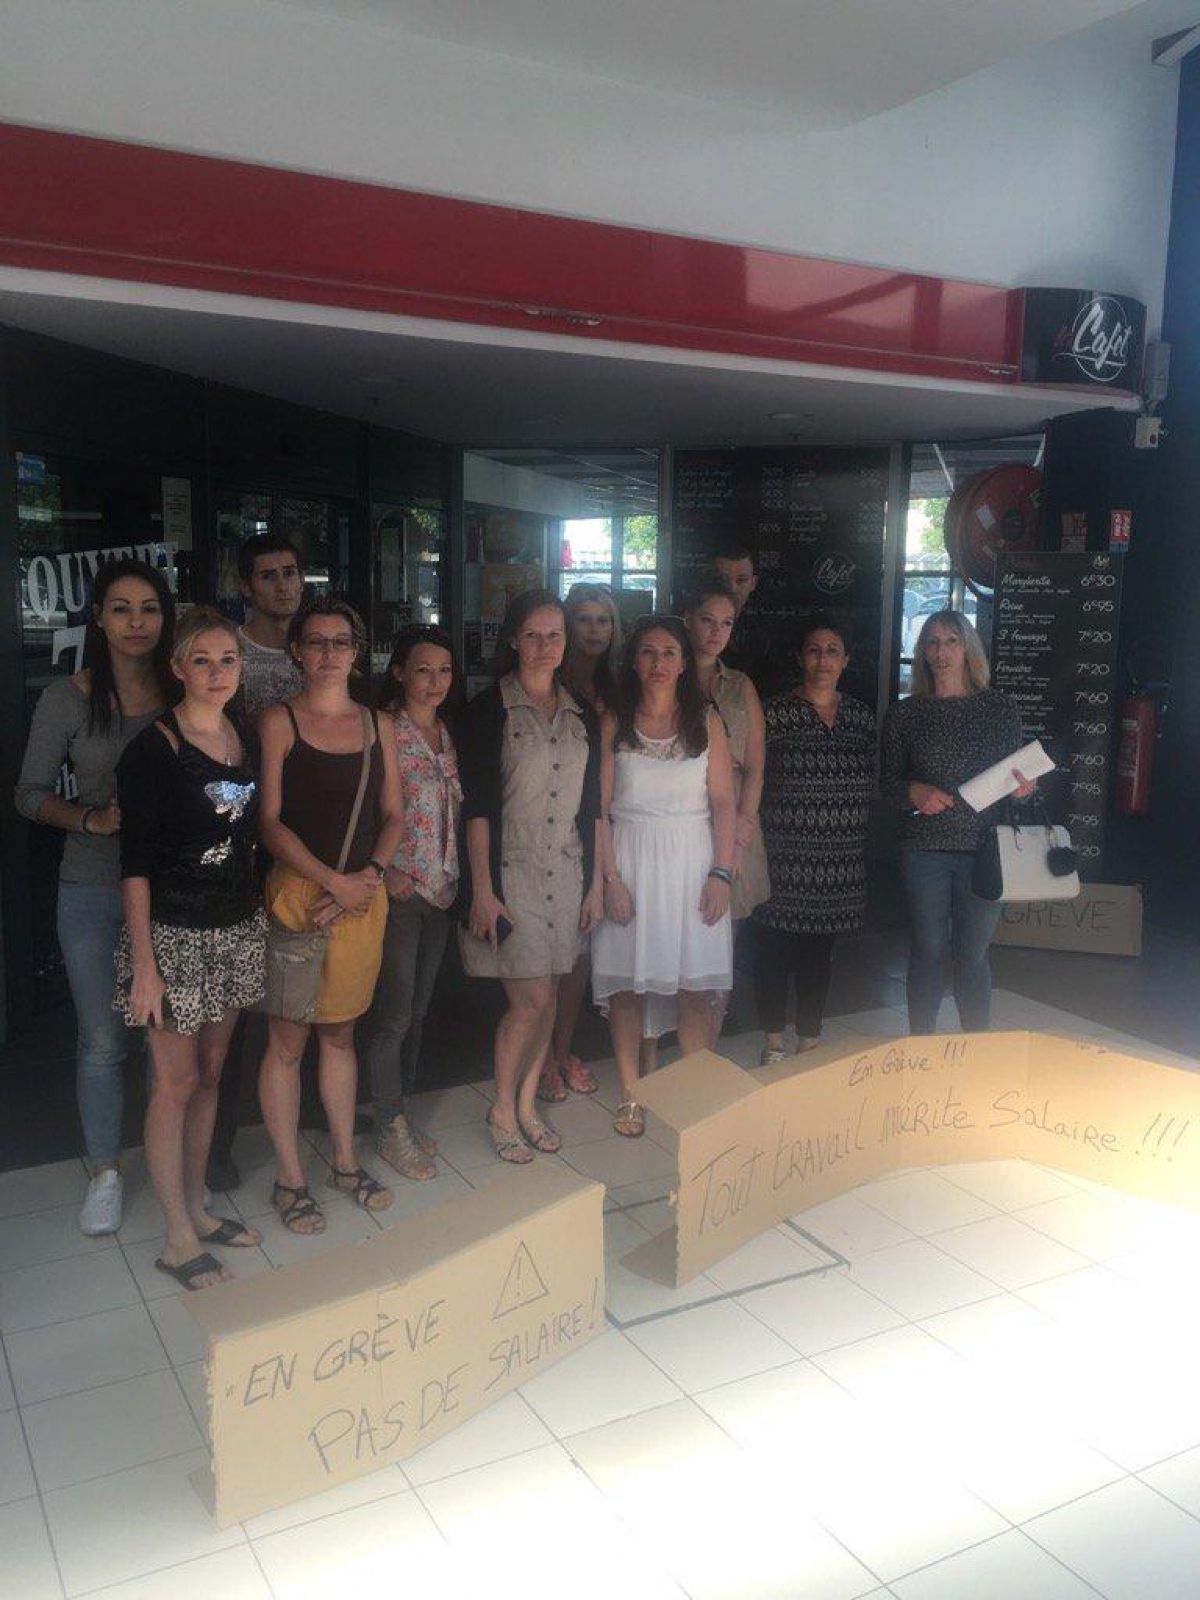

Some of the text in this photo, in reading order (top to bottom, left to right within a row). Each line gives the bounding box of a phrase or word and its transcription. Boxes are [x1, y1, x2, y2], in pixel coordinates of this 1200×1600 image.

[692, 1143, 765, 1237] Tout
[308, 1401, 406, 1474] PAS
[420, 1362, 471, 1430] DE
